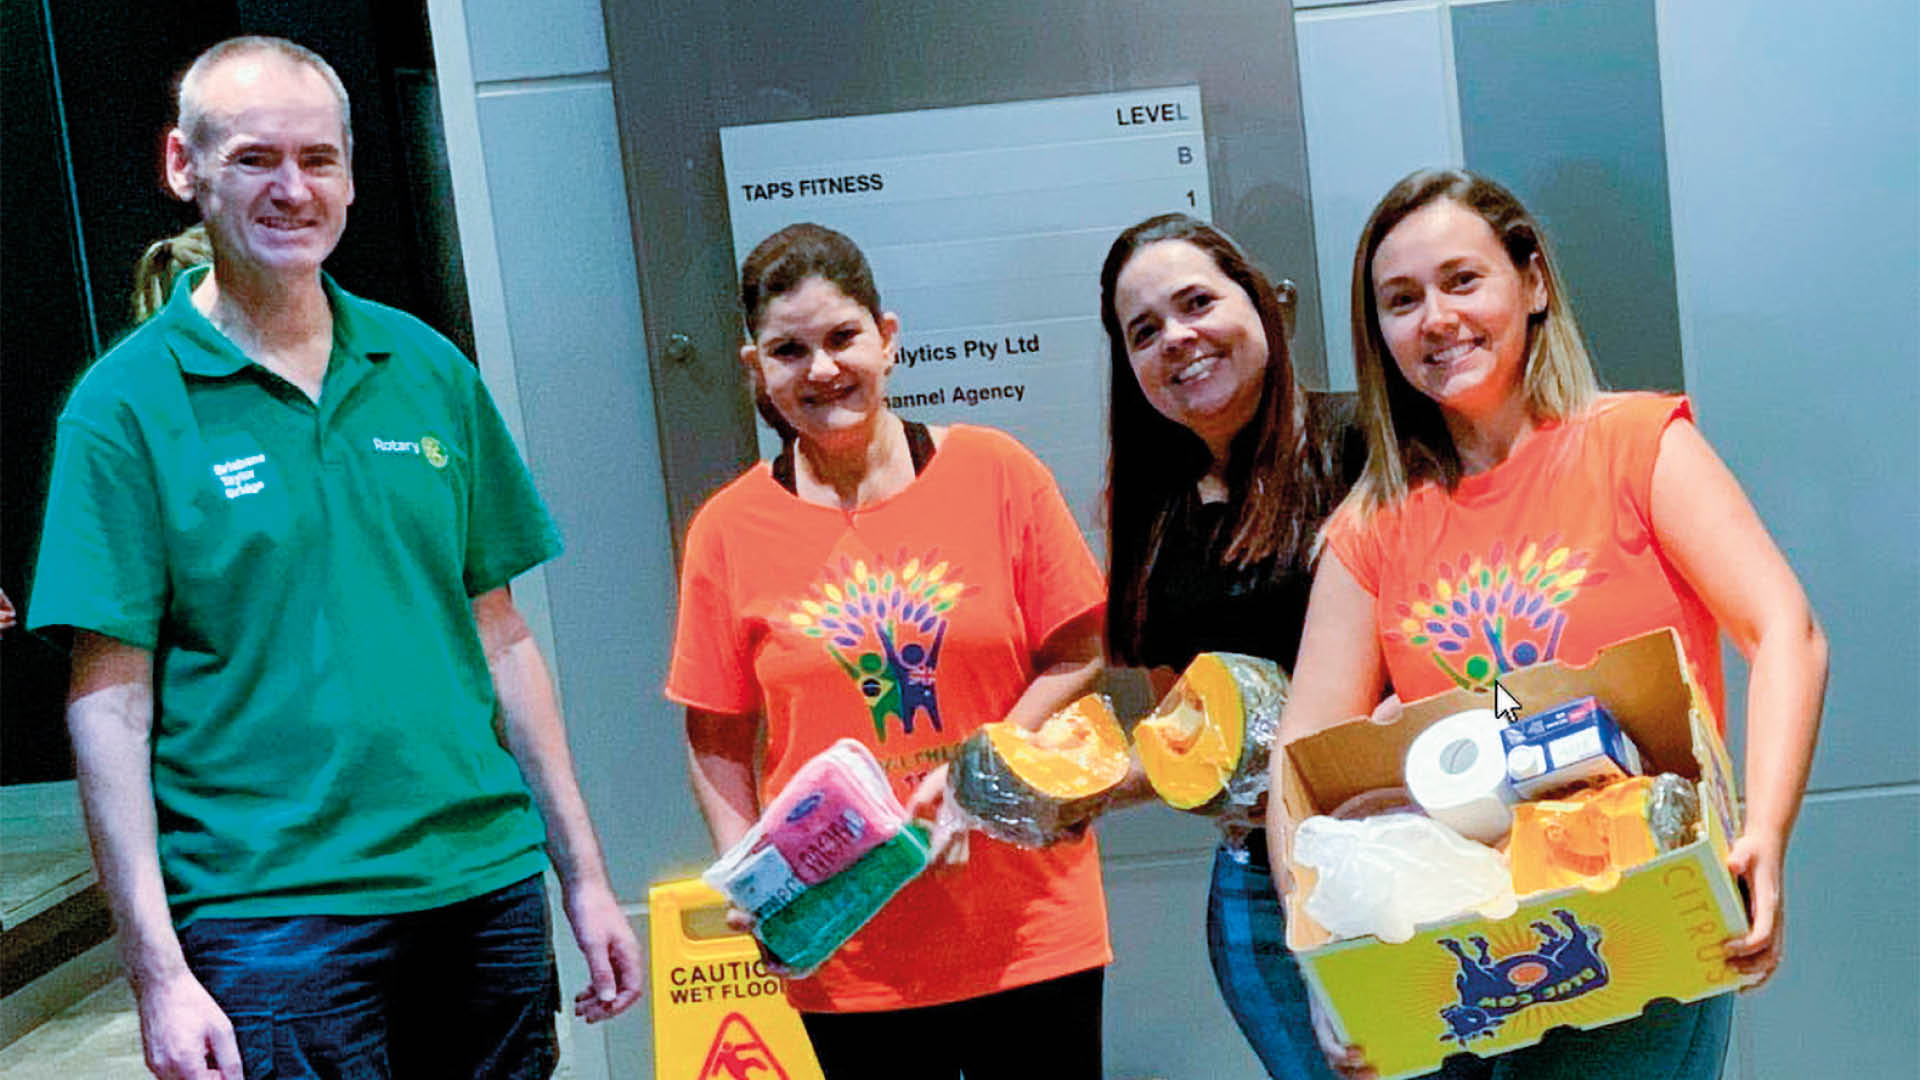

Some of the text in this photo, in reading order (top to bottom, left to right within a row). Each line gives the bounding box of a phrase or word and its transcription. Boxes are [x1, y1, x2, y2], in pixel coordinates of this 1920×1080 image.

[1116, 103, 1189, 126] LEVEL
[1177, 145, 1193, 165] B
[742, 173, 884, 202] TAPS FITNESS
[1186, 189, 1196, 208] 1
[964, 340, 998, 361] Pty
[1005, 334, 1040, 355] Ltd
[952, 384, 1025, 406] Agency
[372, 436, 420, 455] Rotary
[670, 986, 716, 1004] WET
